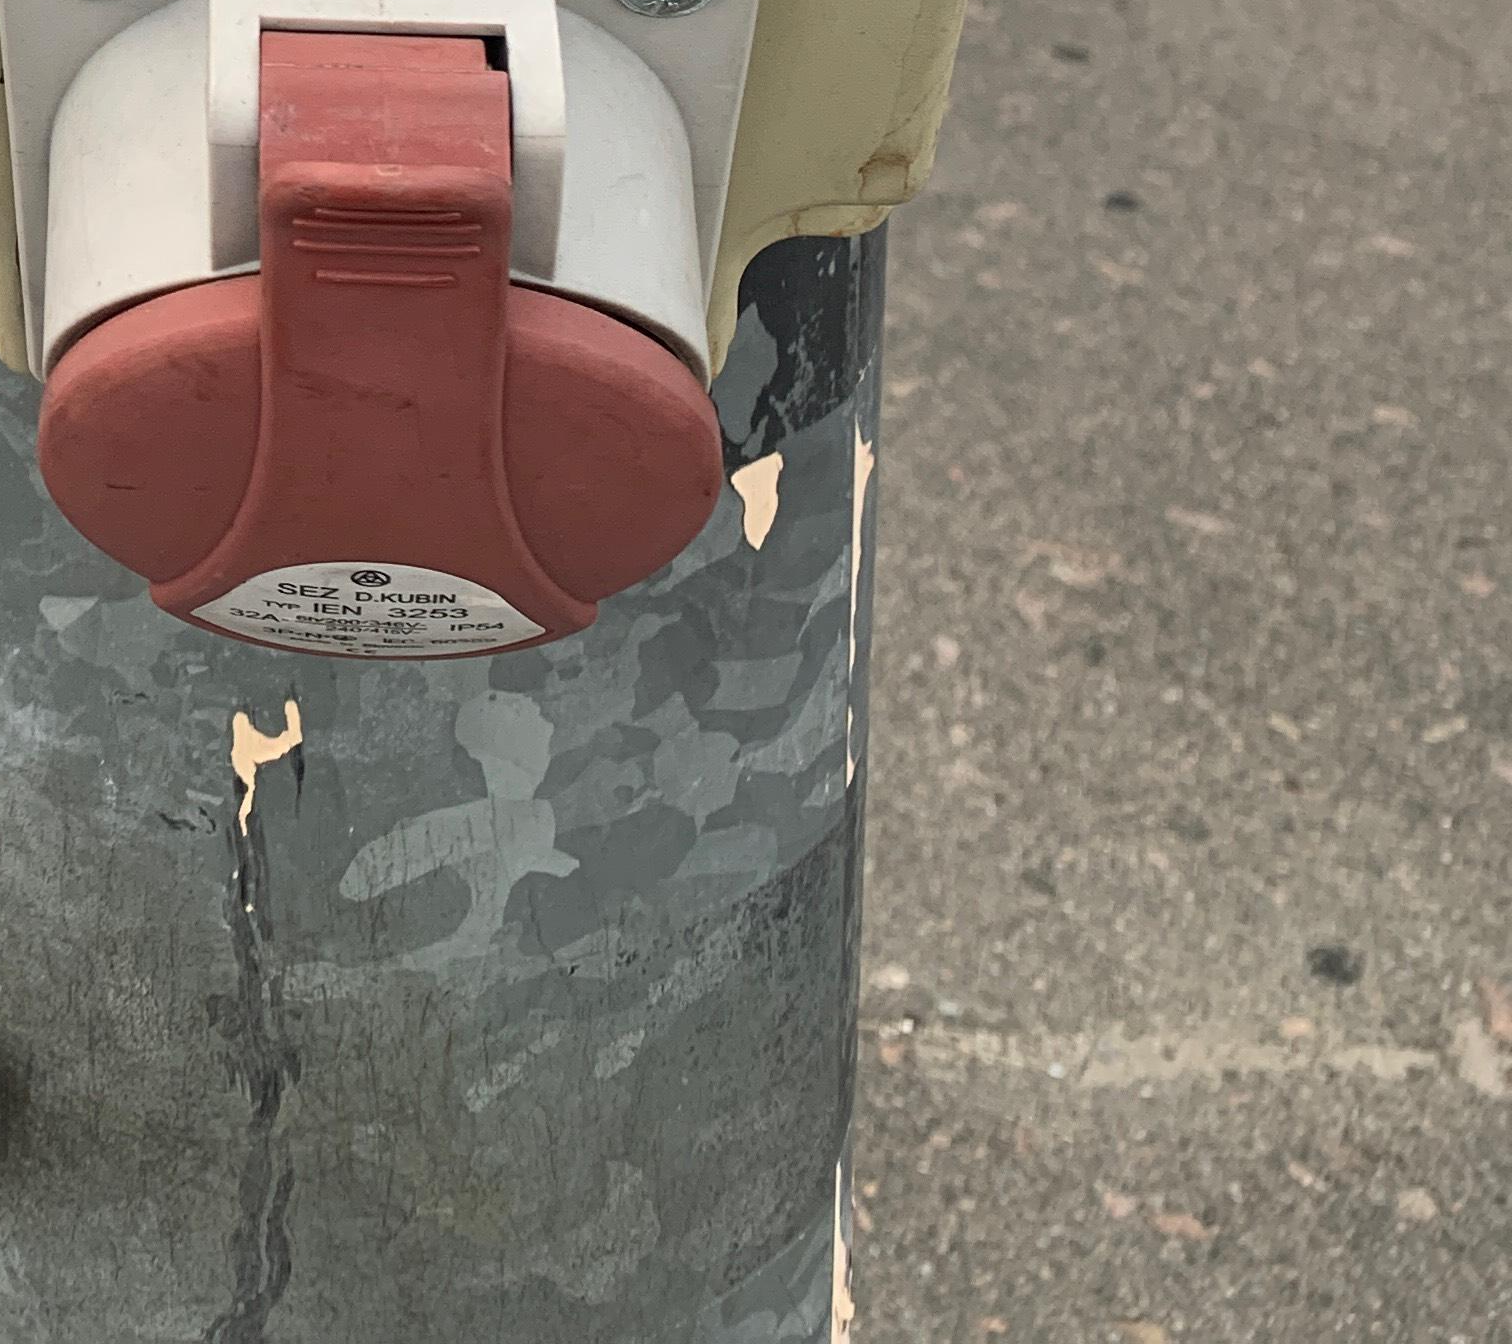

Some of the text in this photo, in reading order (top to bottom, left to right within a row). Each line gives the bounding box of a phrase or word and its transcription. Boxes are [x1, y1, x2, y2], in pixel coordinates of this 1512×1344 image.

[277, 582, 457, 604] SEZ D.KUBIN
[262, 599, 469, 619] TYP IEN 3253
[450, 622, 505, 632] IP54
